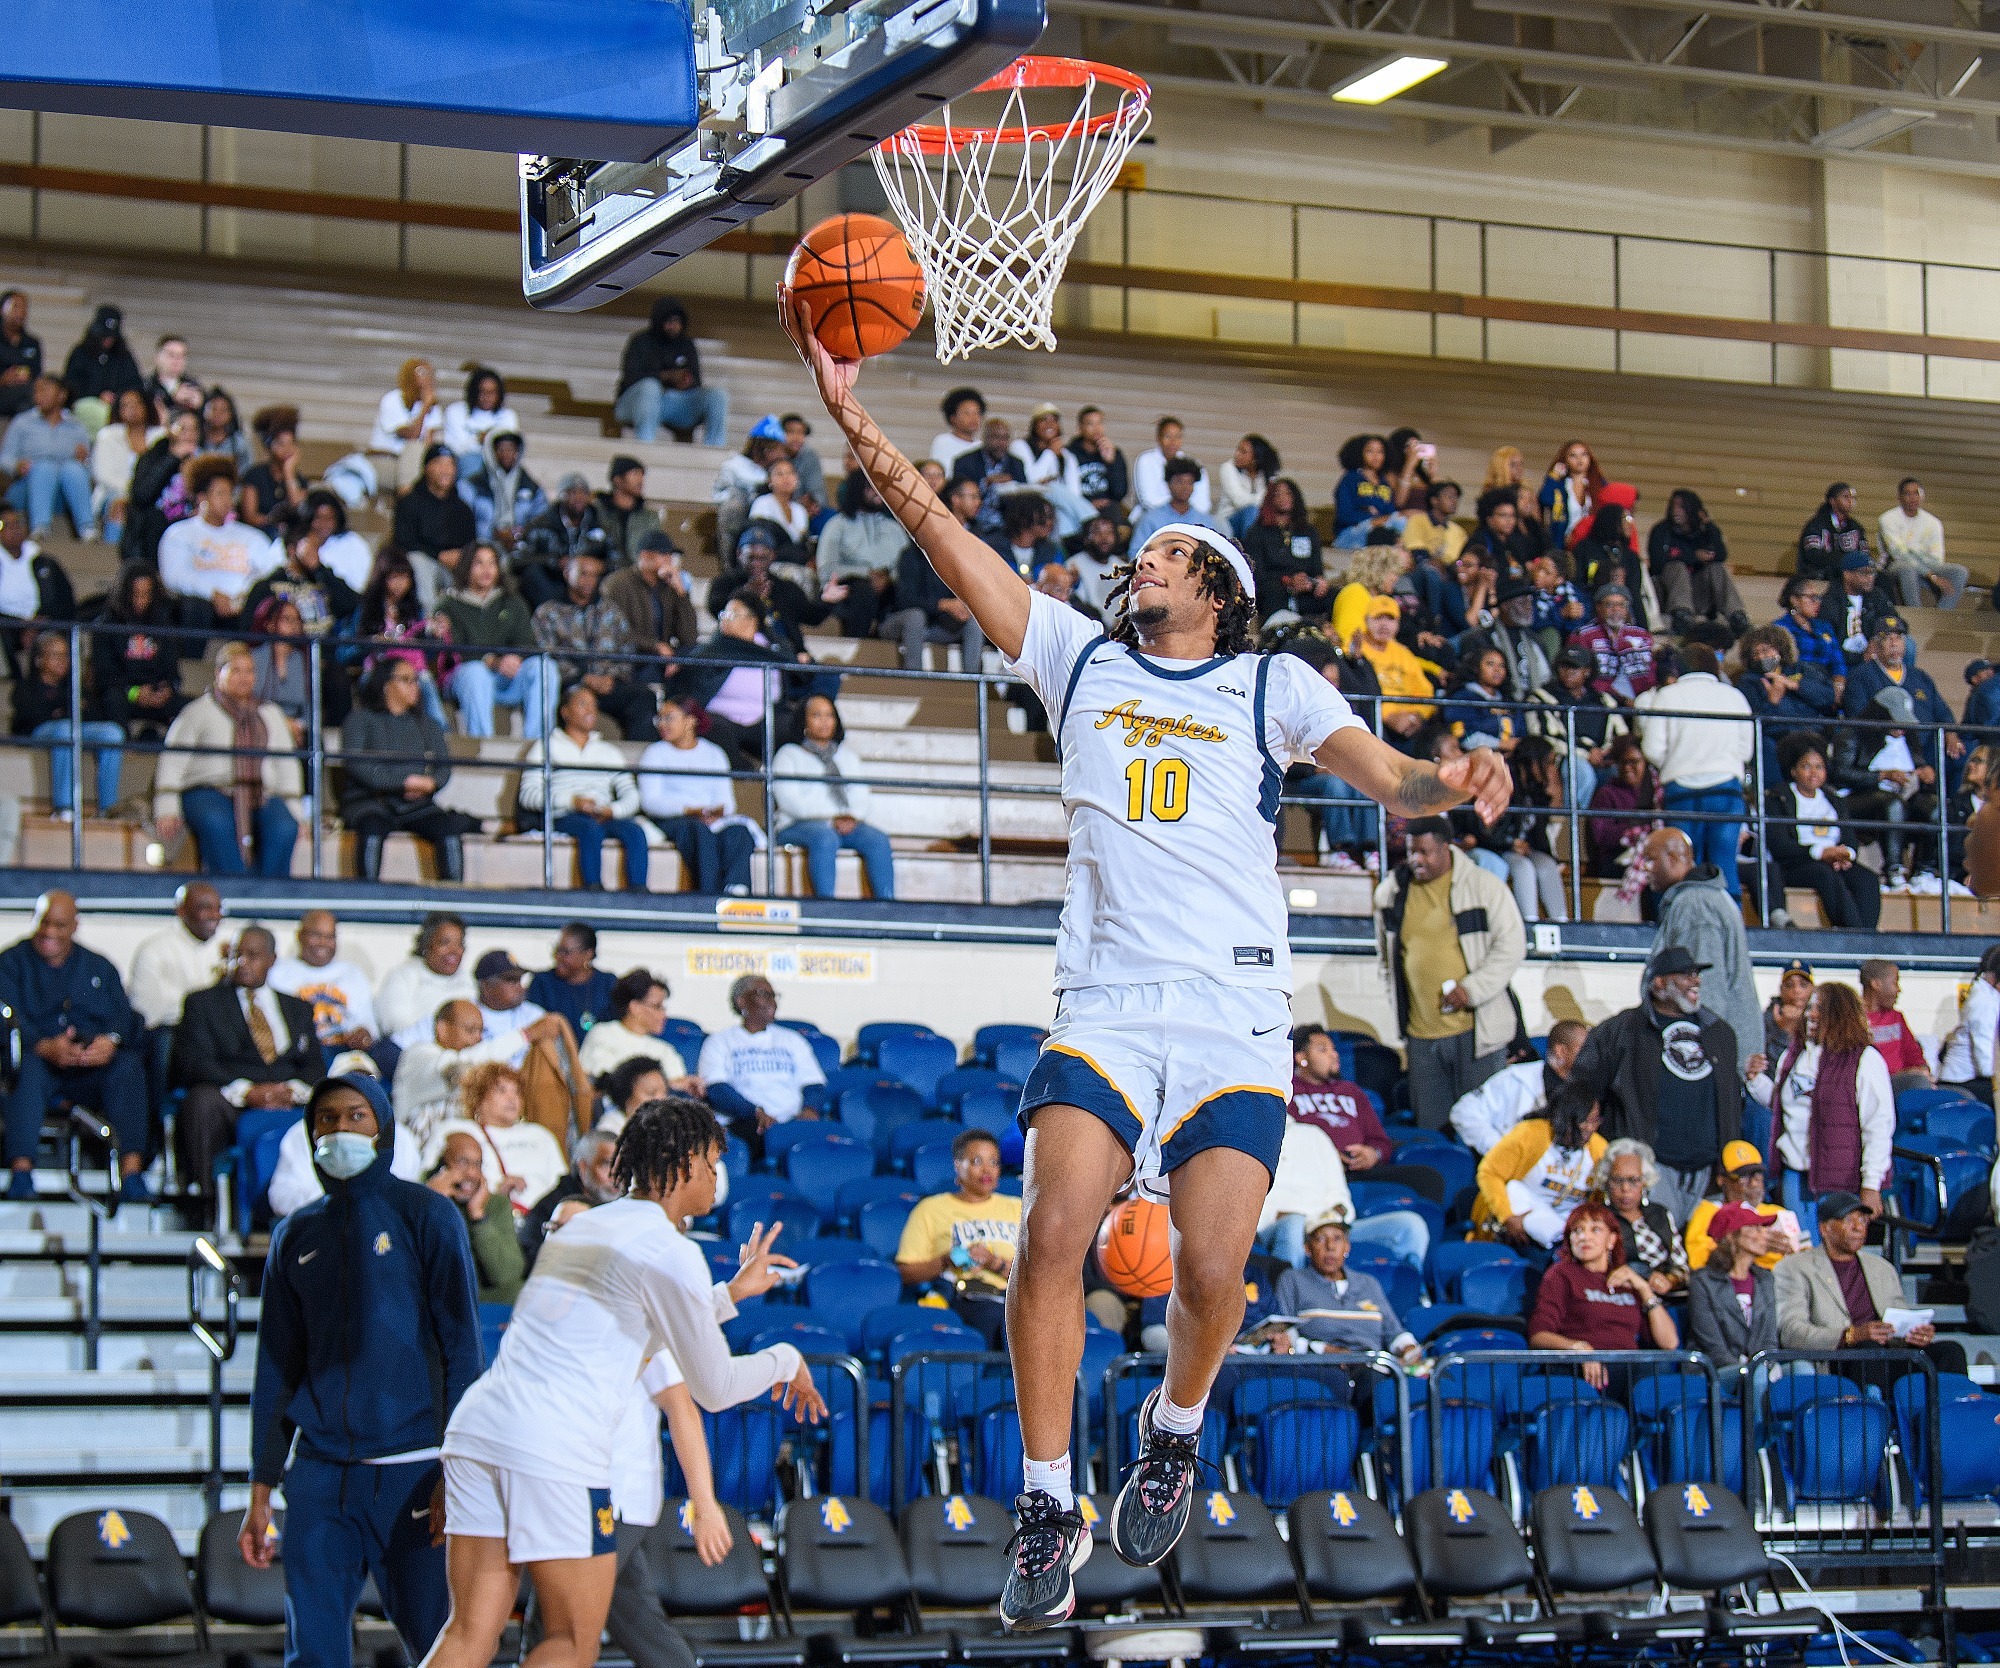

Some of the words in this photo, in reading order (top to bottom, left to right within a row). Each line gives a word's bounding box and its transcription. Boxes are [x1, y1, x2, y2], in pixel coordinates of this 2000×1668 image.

[1217, 685, 1246, 699] CAA
[1094, 699, 1229, 747] Aggies
[1125, 758, 1191, 822] 10
[694, 951, 764, 973] STUDENT
[801, 956, 865, 974] SECTION
[1261, 952, 1270, 961] M
